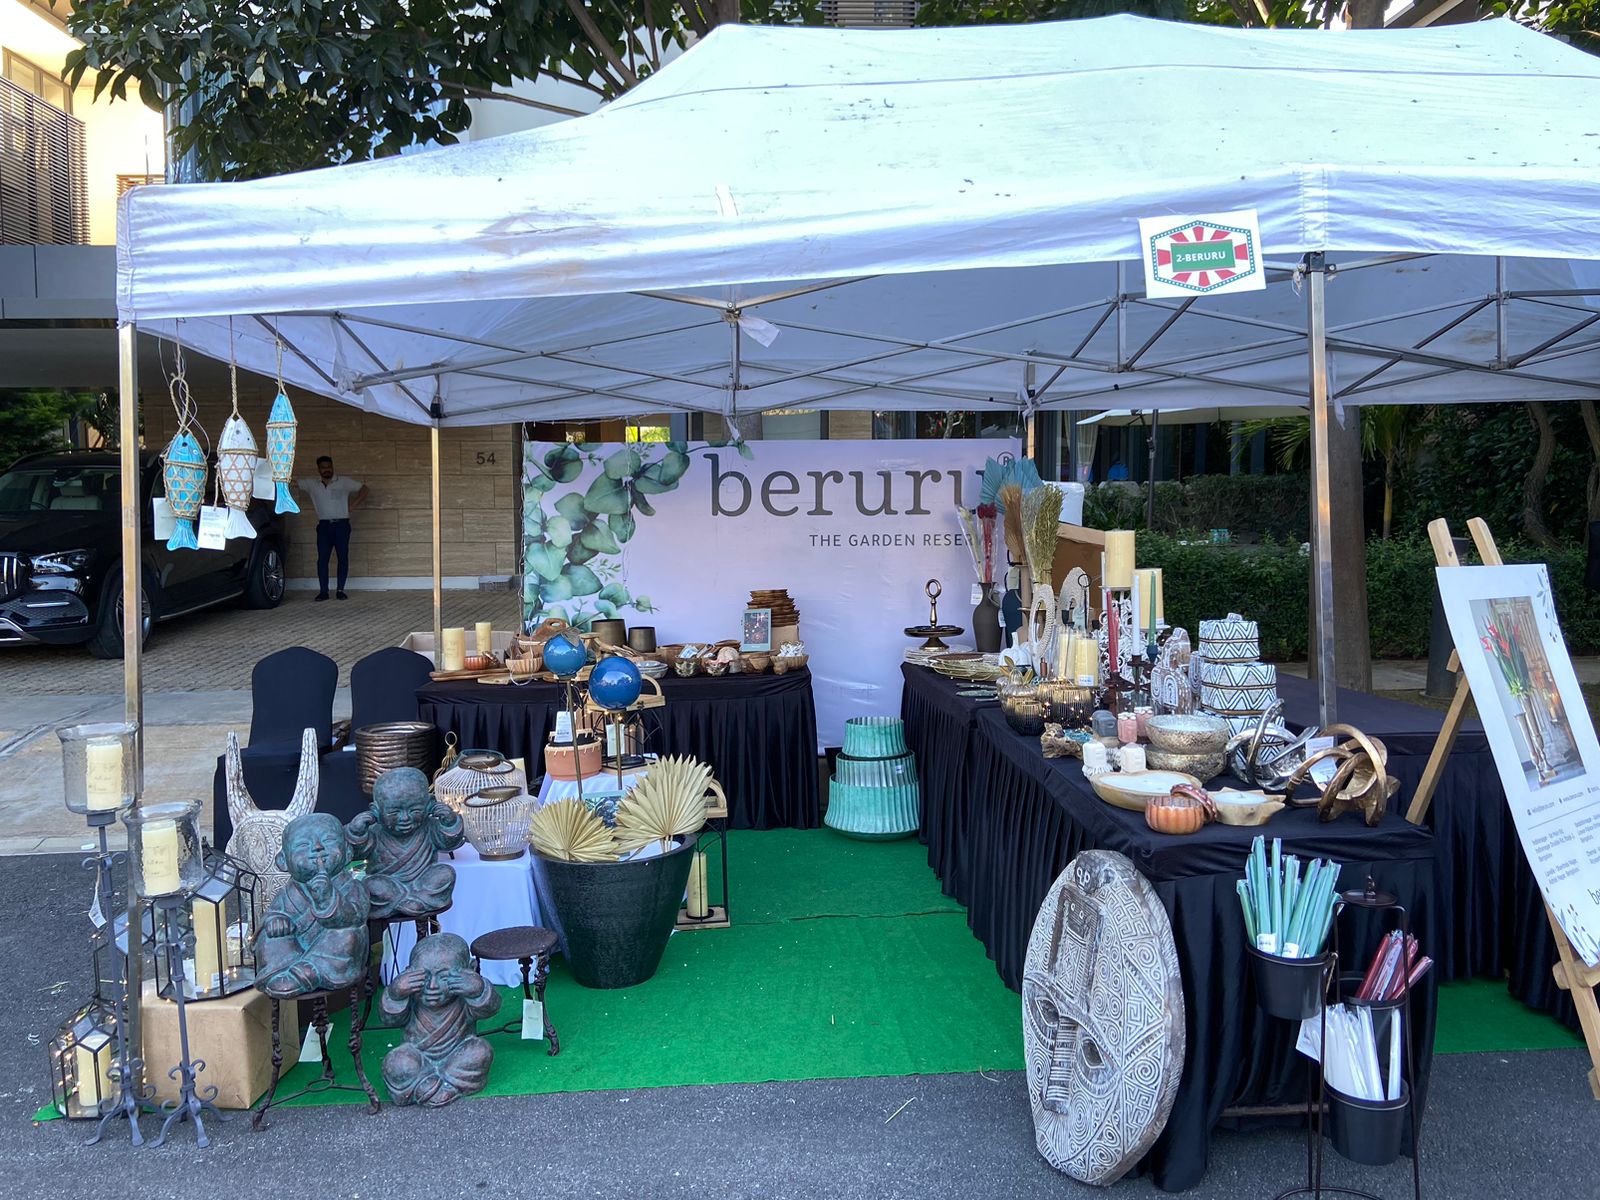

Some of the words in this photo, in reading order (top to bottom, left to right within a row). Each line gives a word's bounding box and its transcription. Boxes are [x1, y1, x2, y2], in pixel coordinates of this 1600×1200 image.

[1175, 250, 1226, 263] 2-BERURU
[476, 451, 496, 465] 54
[809, 534, 841, 547] THE
[848, 534, 916, 547] GARDEN
[923, 534, 984, 547] RESER
